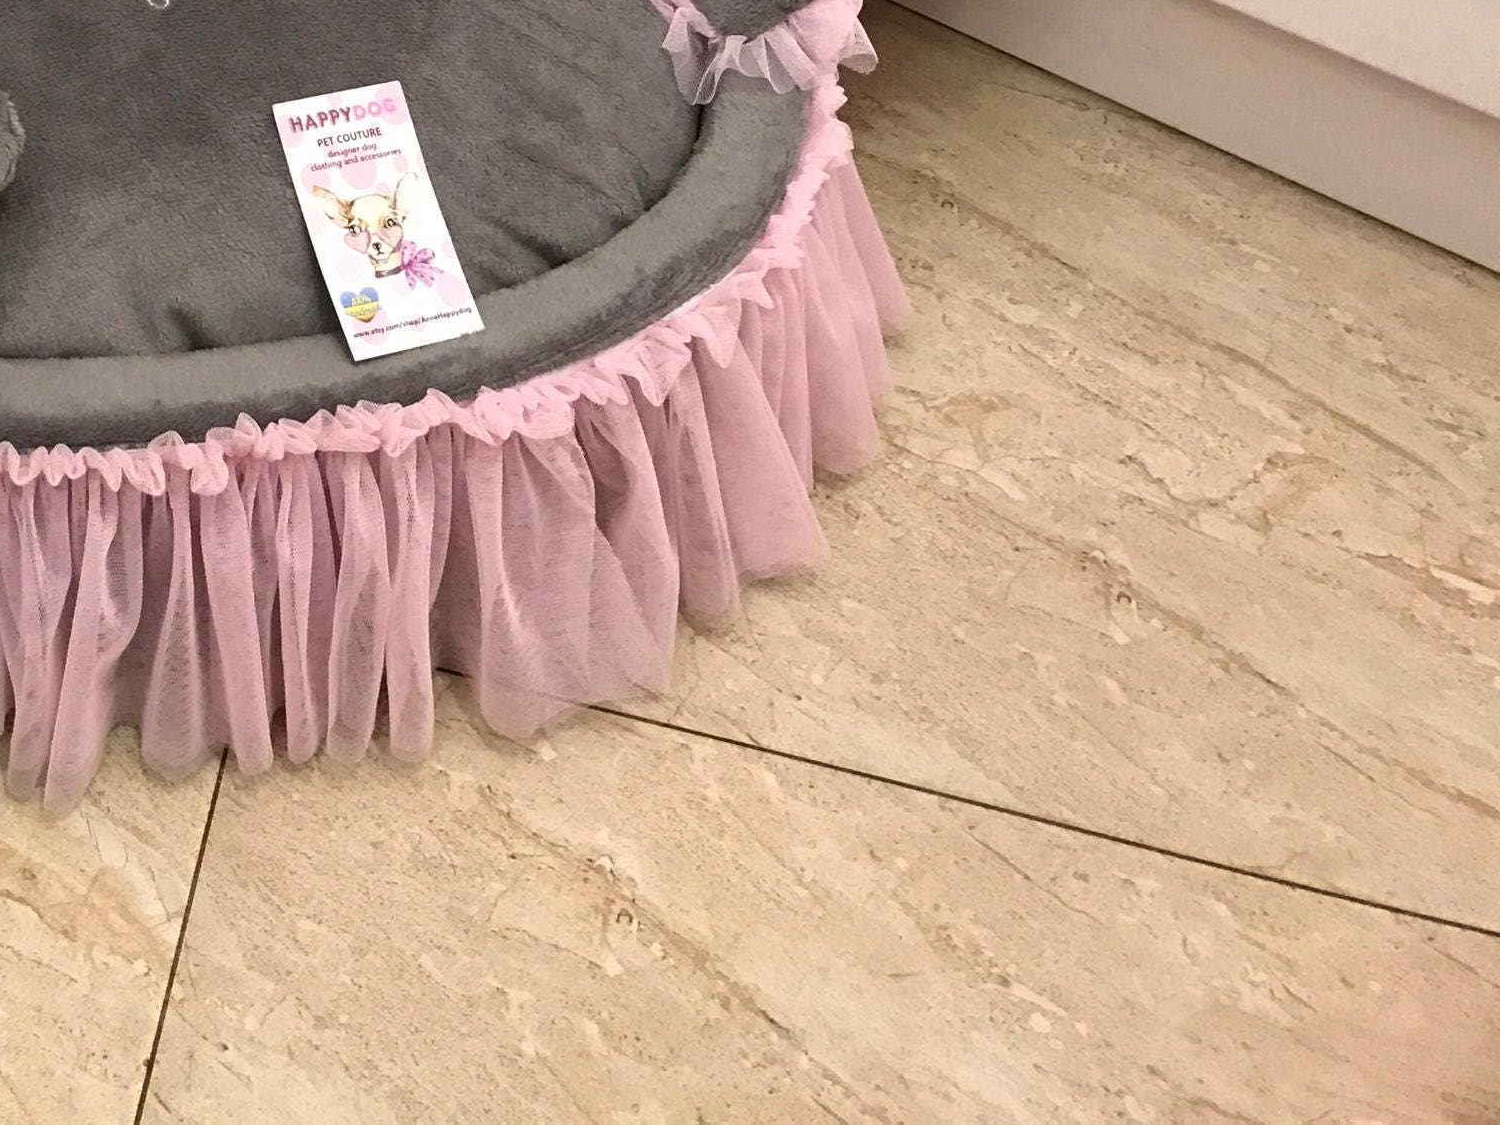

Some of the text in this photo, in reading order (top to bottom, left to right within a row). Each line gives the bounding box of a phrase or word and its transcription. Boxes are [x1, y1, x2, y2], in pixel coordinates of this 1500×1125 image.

[289, 98, 397, 134] HAPPYDOG
[317, 127, 383, 148] PET COUTURE
[311, 149, 401, 172] clothing and accessories
[328, 142, 377, 158] designer dog
